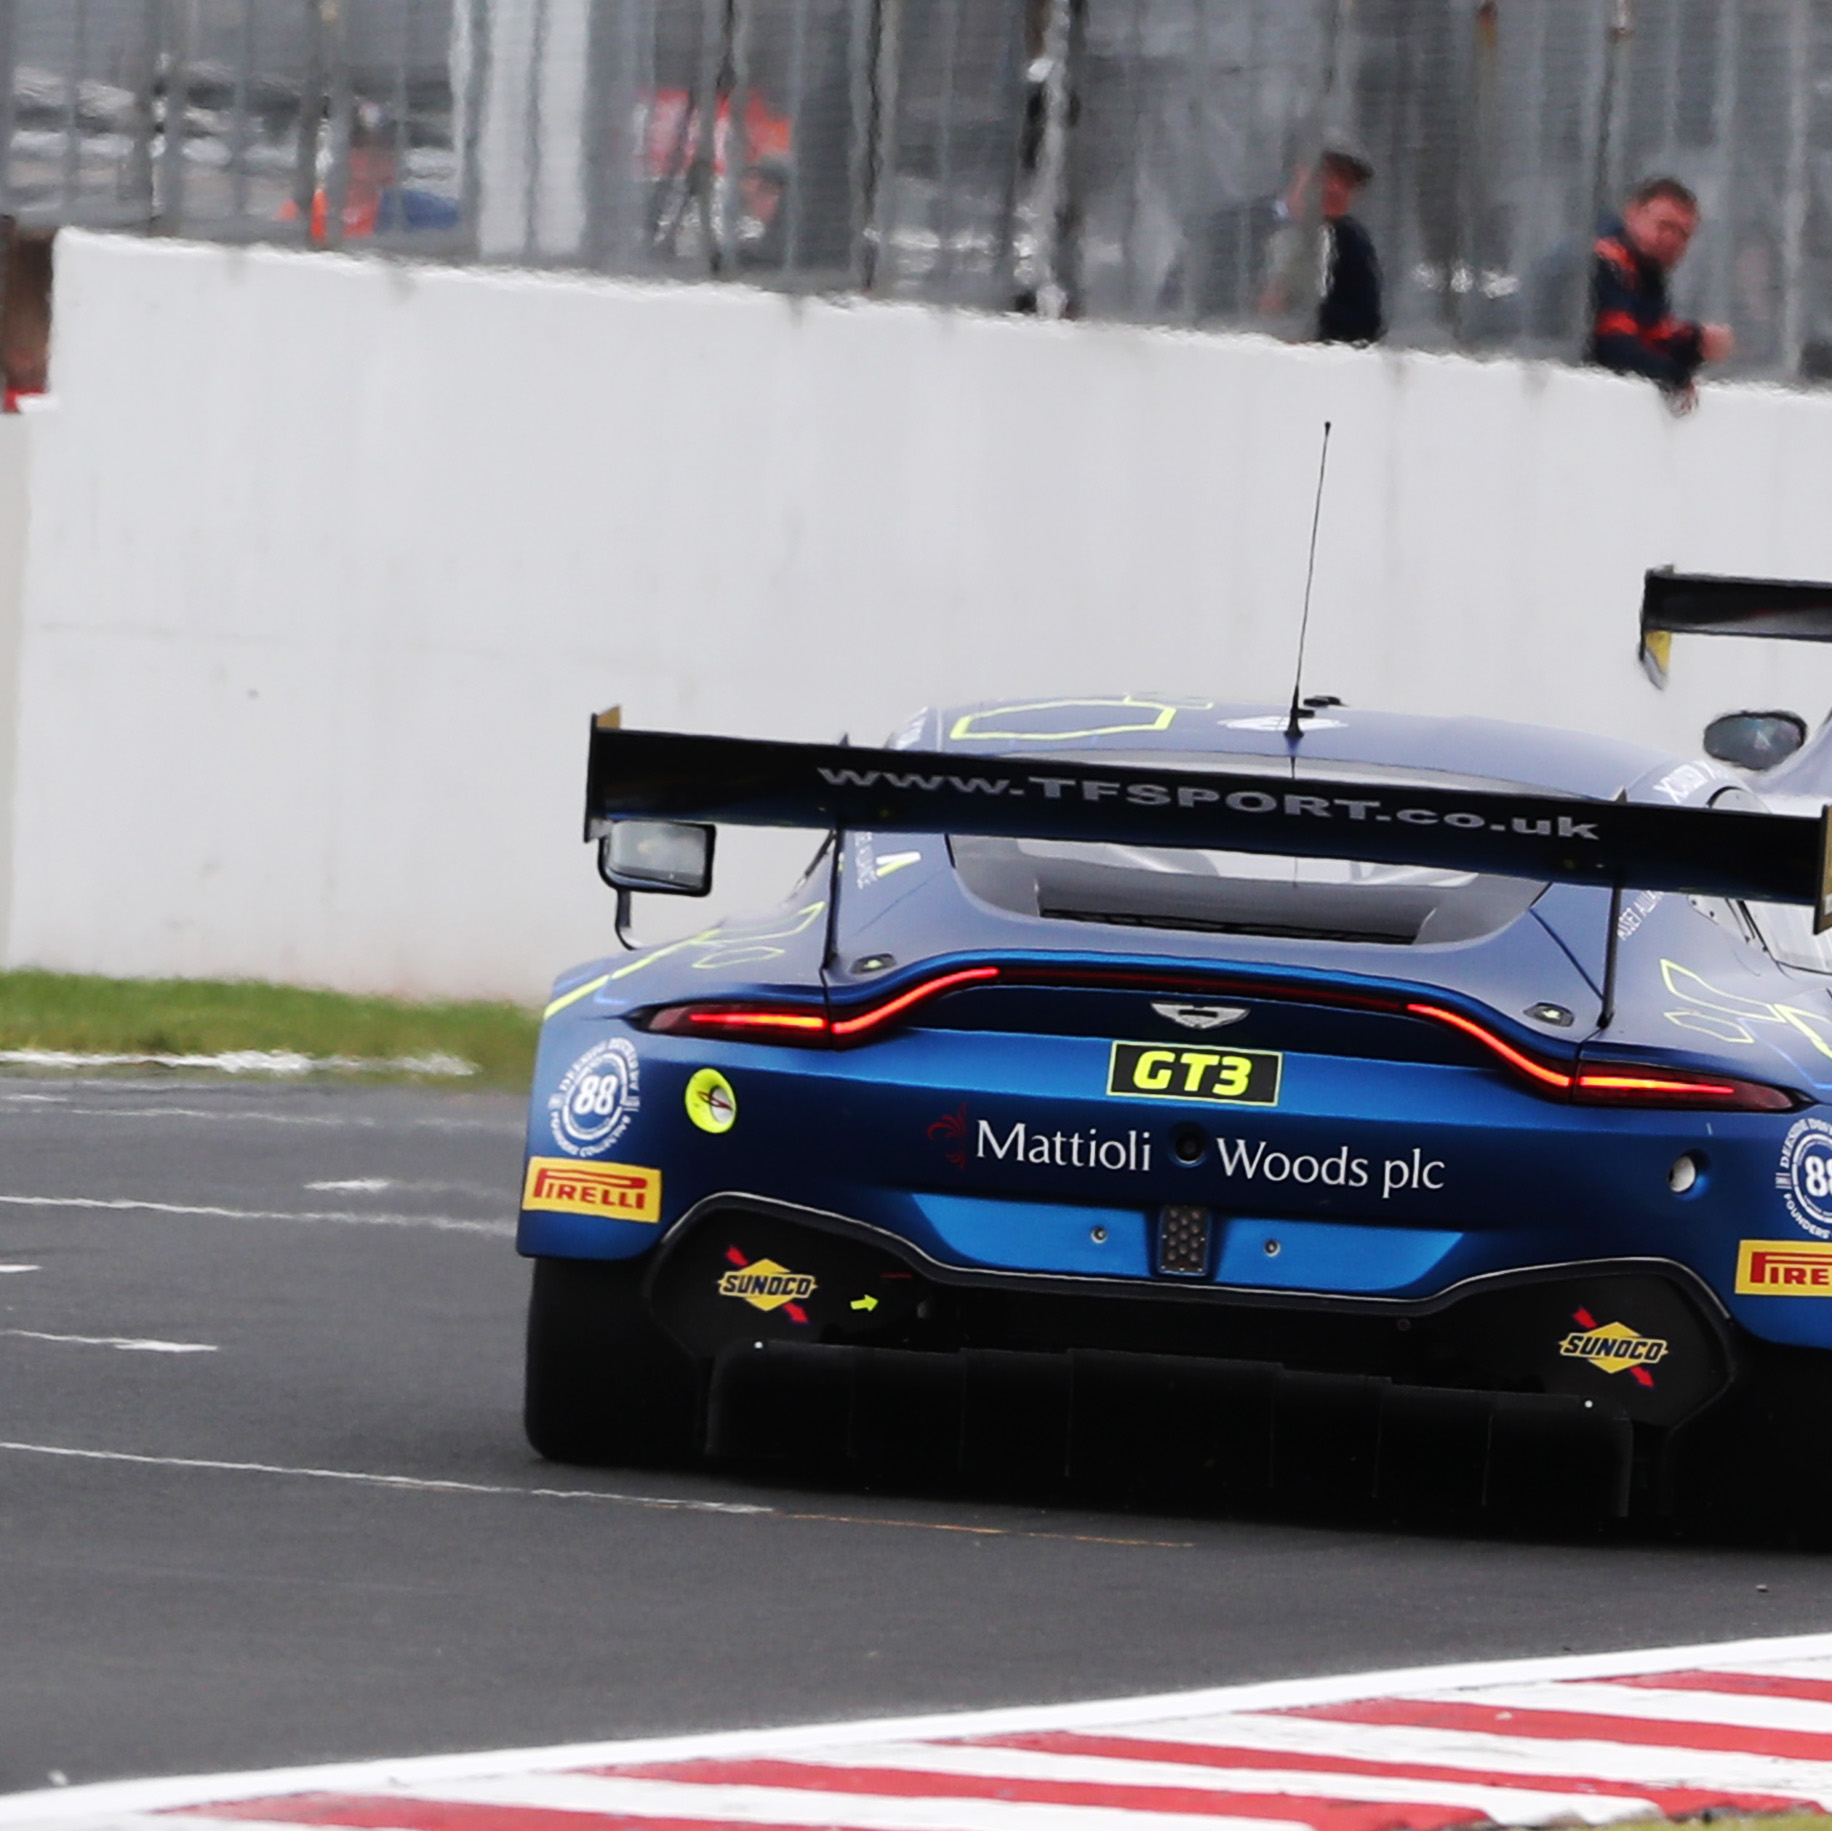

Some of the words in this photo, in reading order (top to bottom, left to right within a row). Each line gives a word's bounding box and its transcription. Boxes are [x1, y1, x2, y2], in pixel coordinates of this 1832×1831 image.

[1132, 1049, 1253, 1097] GT3
[573, 1074, 618, 1115] 88
[975, 1118, 1152, 1171] Mattioli
[1215, 1136, 1370, 1188] Woods
[1382, 1147, 1446, 1199] plc
[532, 1168, 648, 1210] PIRELLI
[721, 1273, 813, 1297] SUNOCO
[1562, 1334, 1664, 1362] SUNOCO
